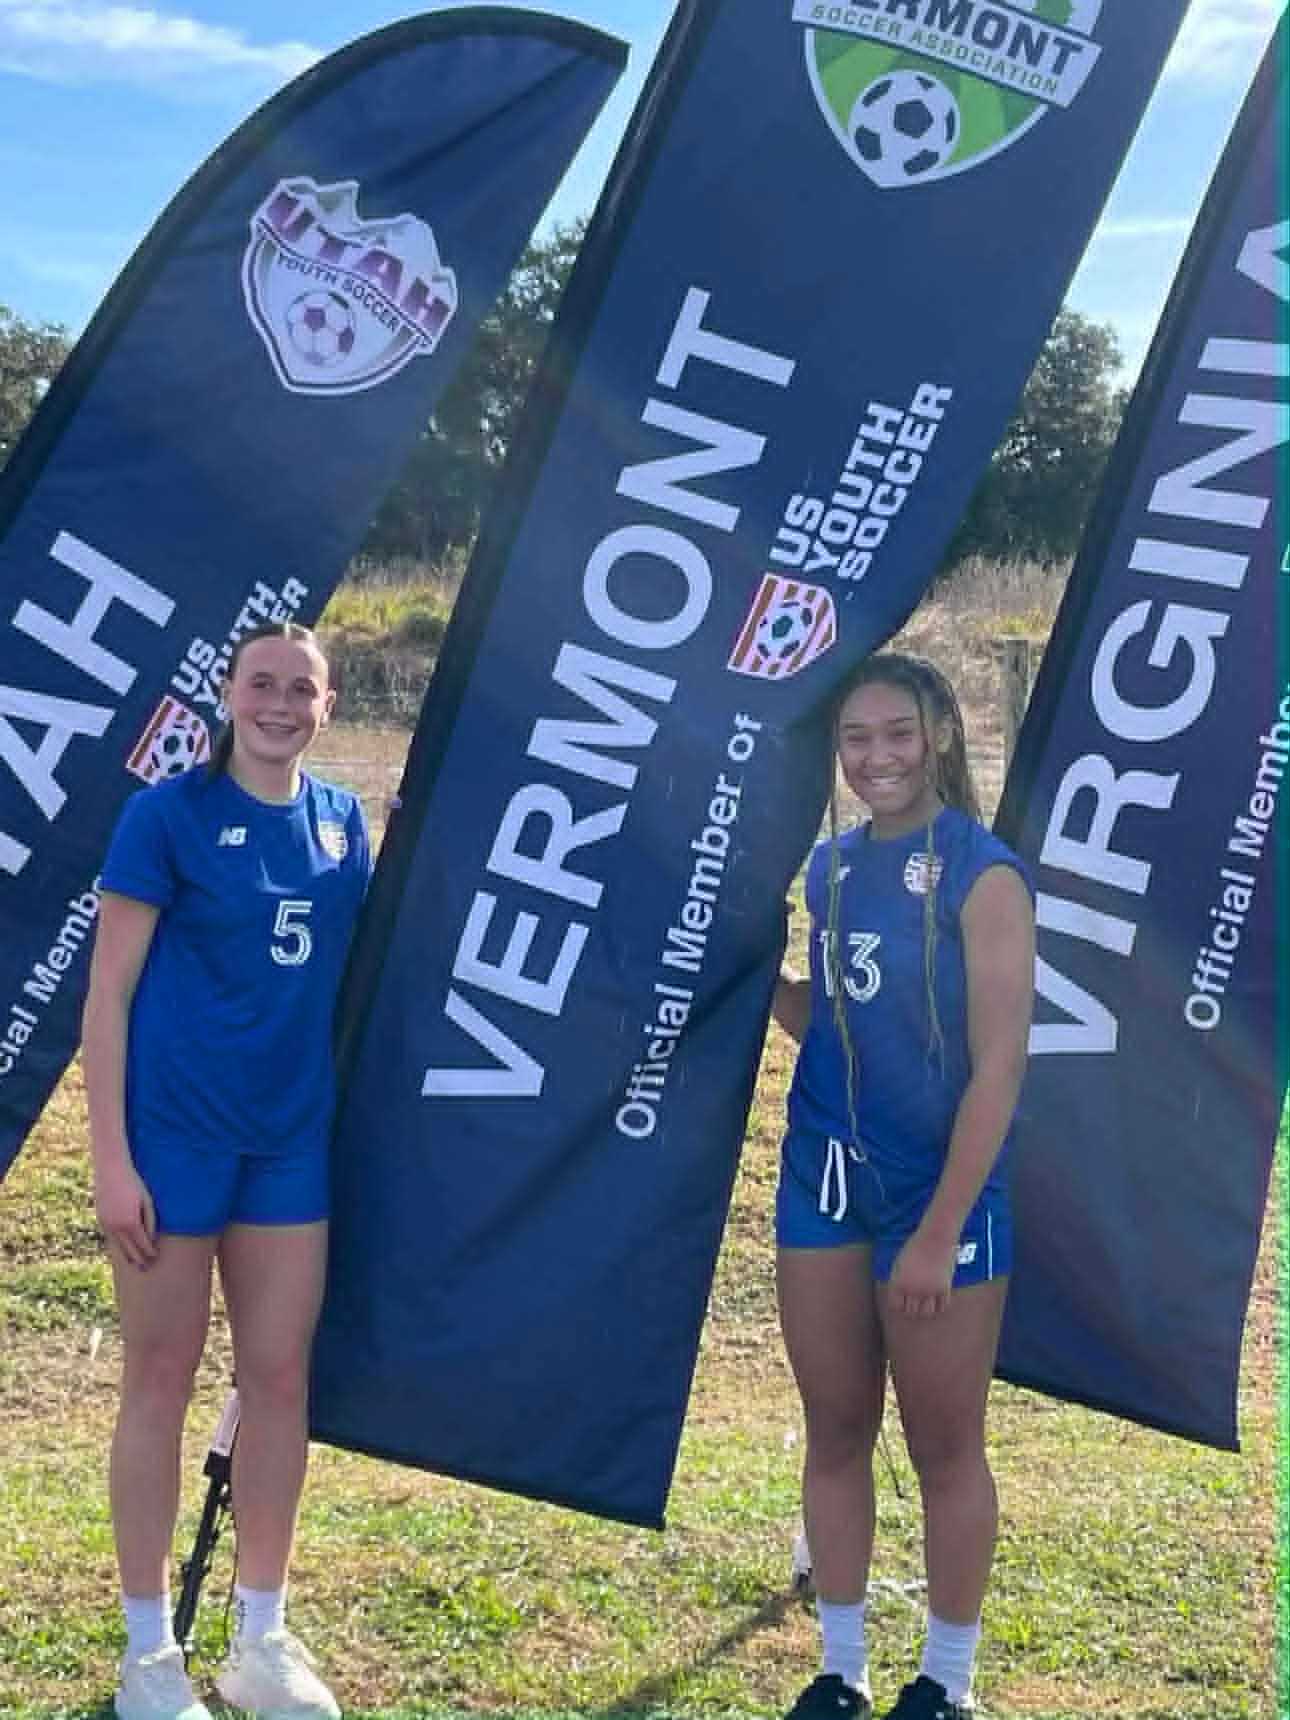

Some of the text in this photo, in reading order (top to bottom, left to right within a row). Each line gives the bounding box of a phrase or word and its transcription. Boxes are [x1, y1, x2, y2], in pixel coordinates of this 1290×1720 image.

[811, 4, 1058, 94] SOCCER ASSOCIATION
[277, 253, 401, 332] YOUTH SOCCER
[769, 494, 825, 567] US
[803, 400, 904, 573] YOUTH
[837, 382, 953, 582] SOCCER
[171, 637, 217, 695] US
[193, 580, 277, 705] YOTH
[422, 286, 796, 1099] VERMONT
[270, 900, 313, 967] 5
[615, 711, 763, 1139] Official Member of
[1184, 869, 1256, 1031] Official
